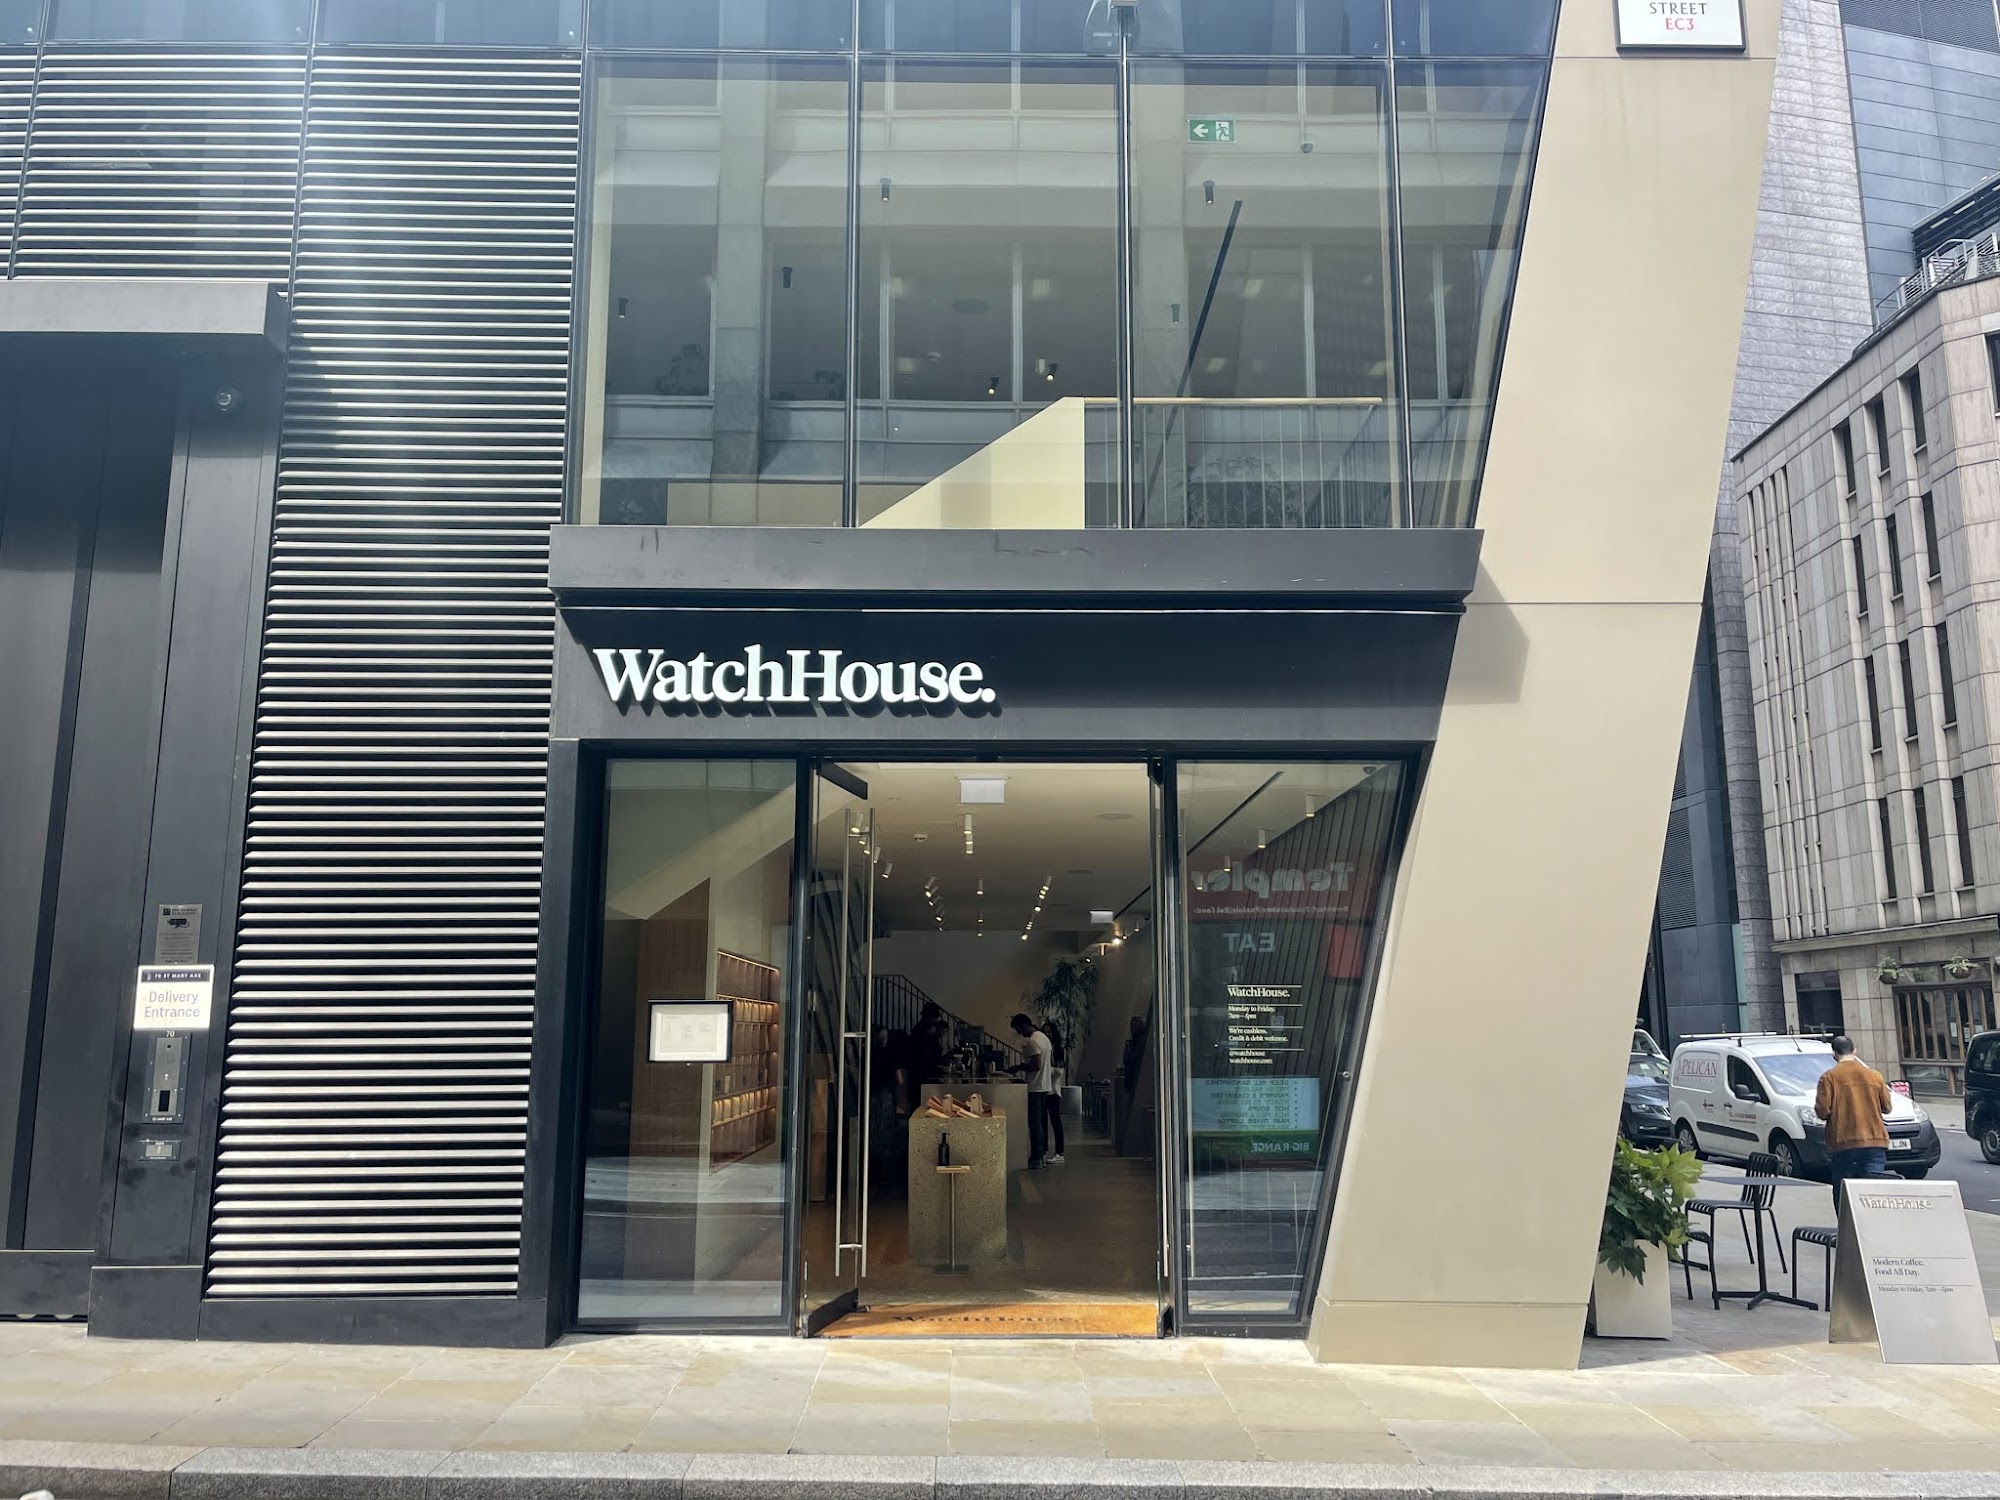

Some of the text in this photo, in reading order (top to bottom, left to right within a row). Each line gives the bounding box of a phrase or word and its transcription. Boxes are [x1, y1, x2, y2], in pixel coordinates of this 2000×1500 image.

[1649, 2, 1708, 15] STREET
[1665, 17, 1695, 31] EC3
[593, 643, 997, 704] WatchHouse.
[149, 990, 199, 1004] Delivery
[1227, 986, 1291, 998] WatchHouse.
[144, 1006, 201, 1018] Entrance
[1228, 1005, 1251, 1013] Monday
[165, 1030, 176, 1038] 70
[1681, 1059, 1718, 1075] PELICAN
[1891, 1140, 1907, 1149] LJN
[1872, 1258, 1925, 1267] Modern Coffee.
[1874, 1268, 1920, 1278] Food All Day.
